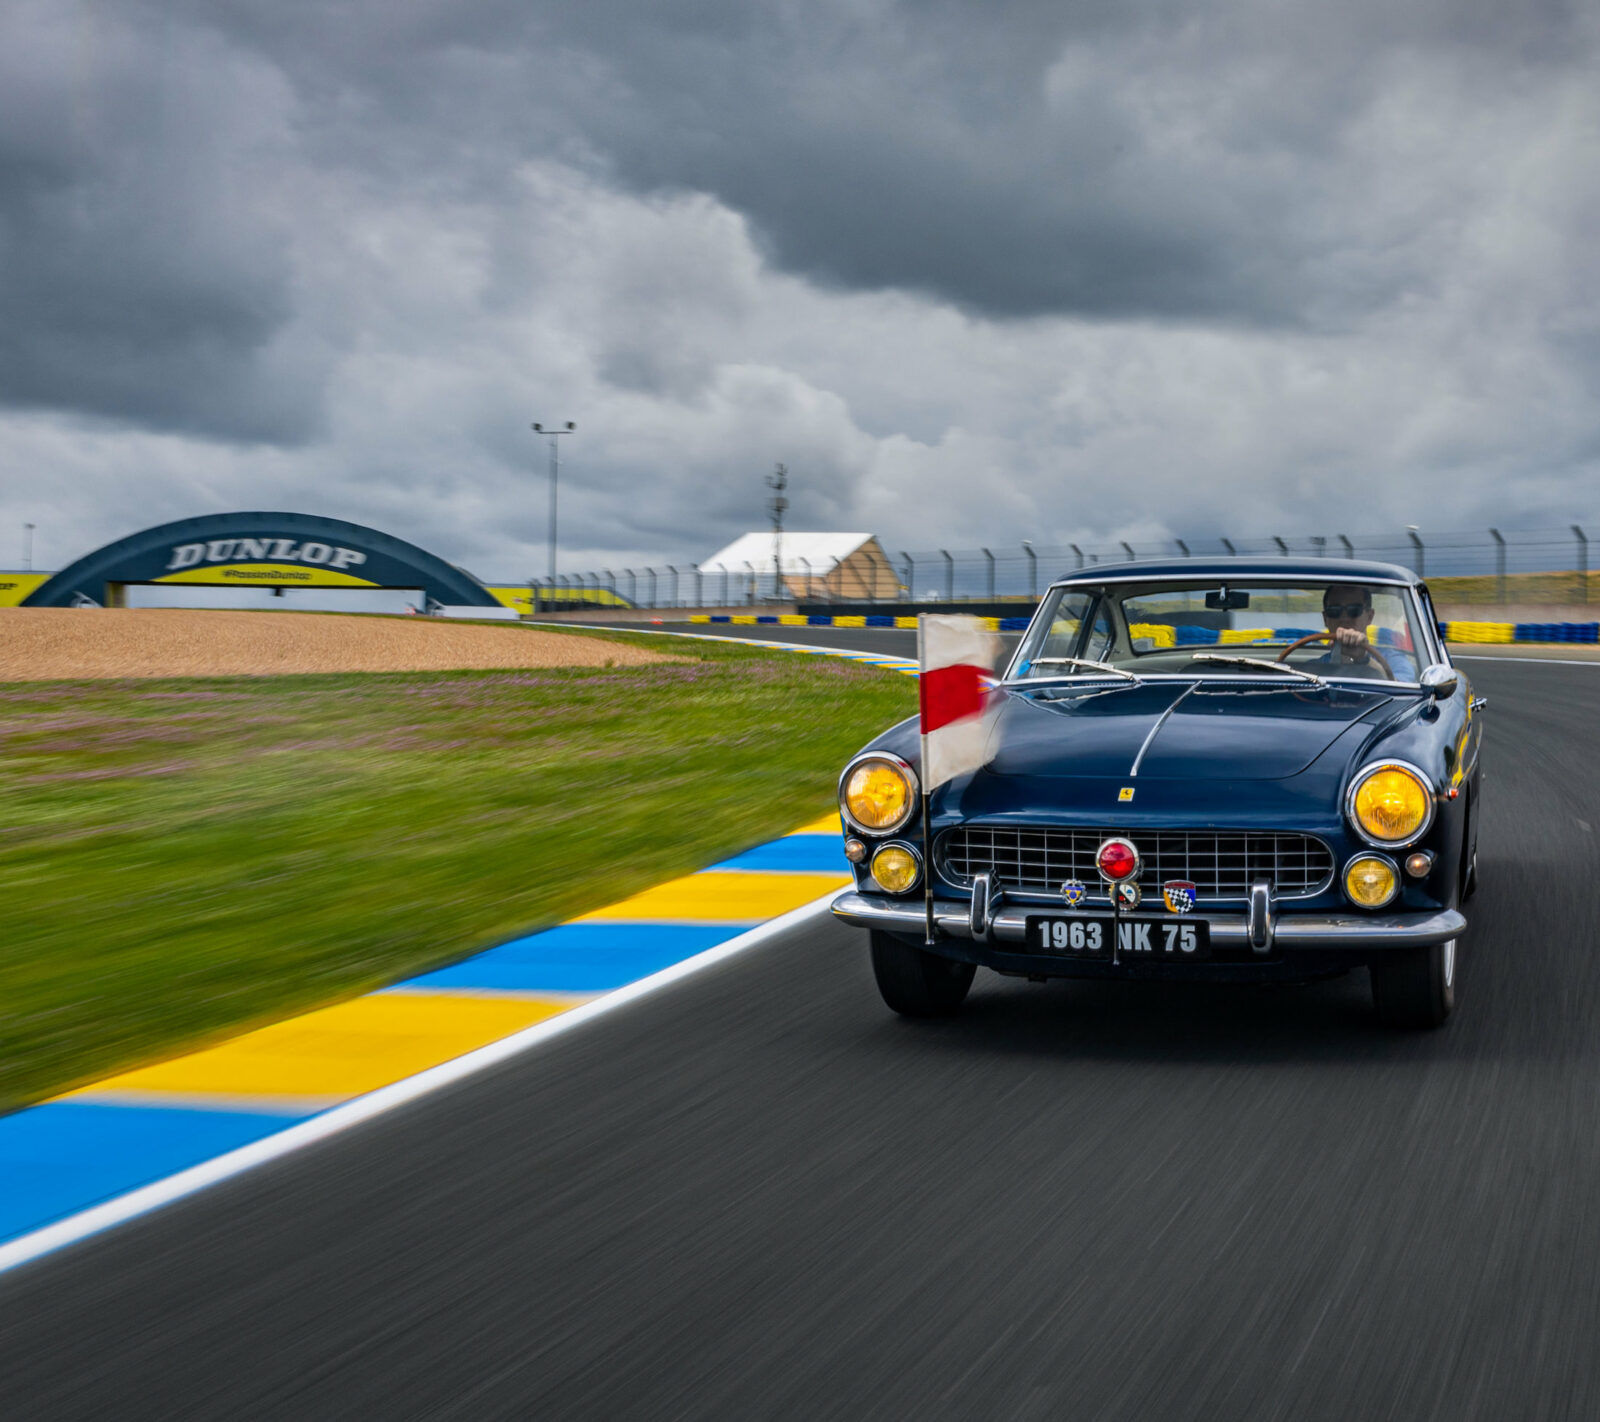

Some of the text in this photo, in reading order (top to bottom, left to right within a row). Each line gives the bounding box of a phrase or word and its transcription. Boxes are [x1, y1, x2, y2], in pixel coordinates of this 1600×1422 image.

[167, 538, 367, 570] DUNLOP
[1038, 921, 1197, 952] 1963 NK 75
